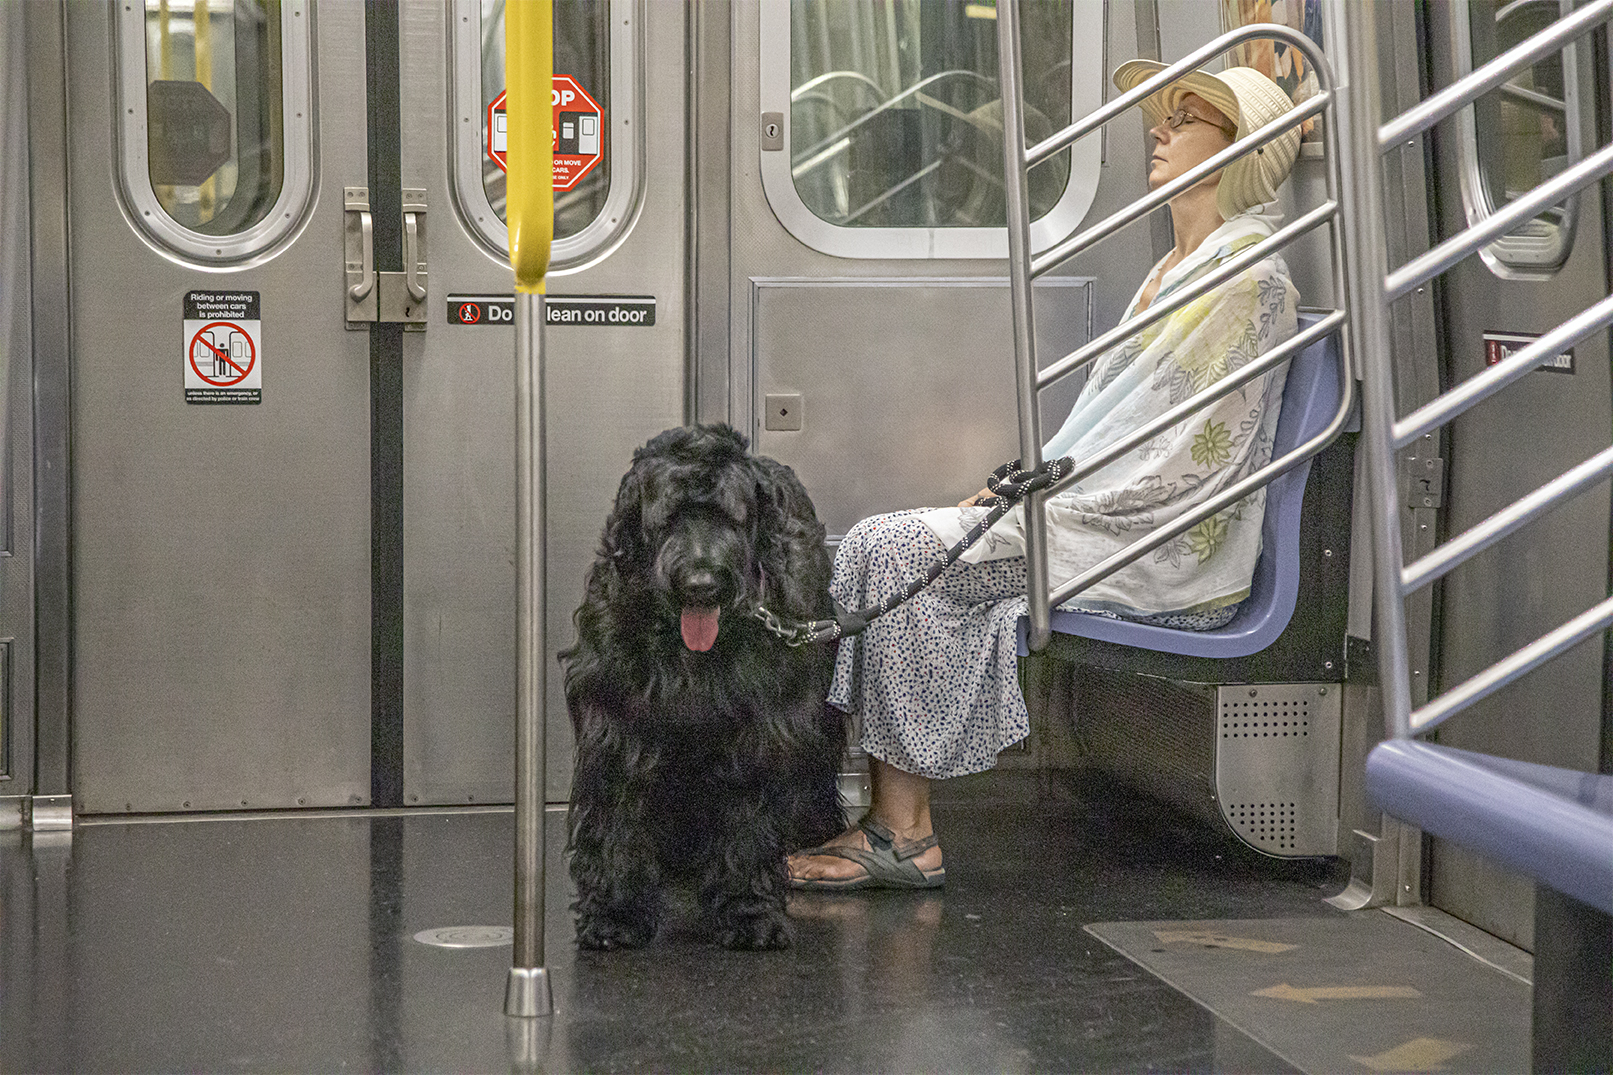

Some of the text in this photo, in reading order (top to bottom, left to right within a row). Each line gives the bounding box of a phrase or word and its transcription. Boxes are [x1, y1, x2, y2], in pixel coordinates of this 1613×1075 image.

[552, 89, 576, 106] OP
[190, 293, 215, 303] Riding
[225, 293, 253, 303] moving
[197, 302, 229, 310] between
[207, 311, 245, 319] prohibited
[488, 305, 647, 323] Do lean on door
